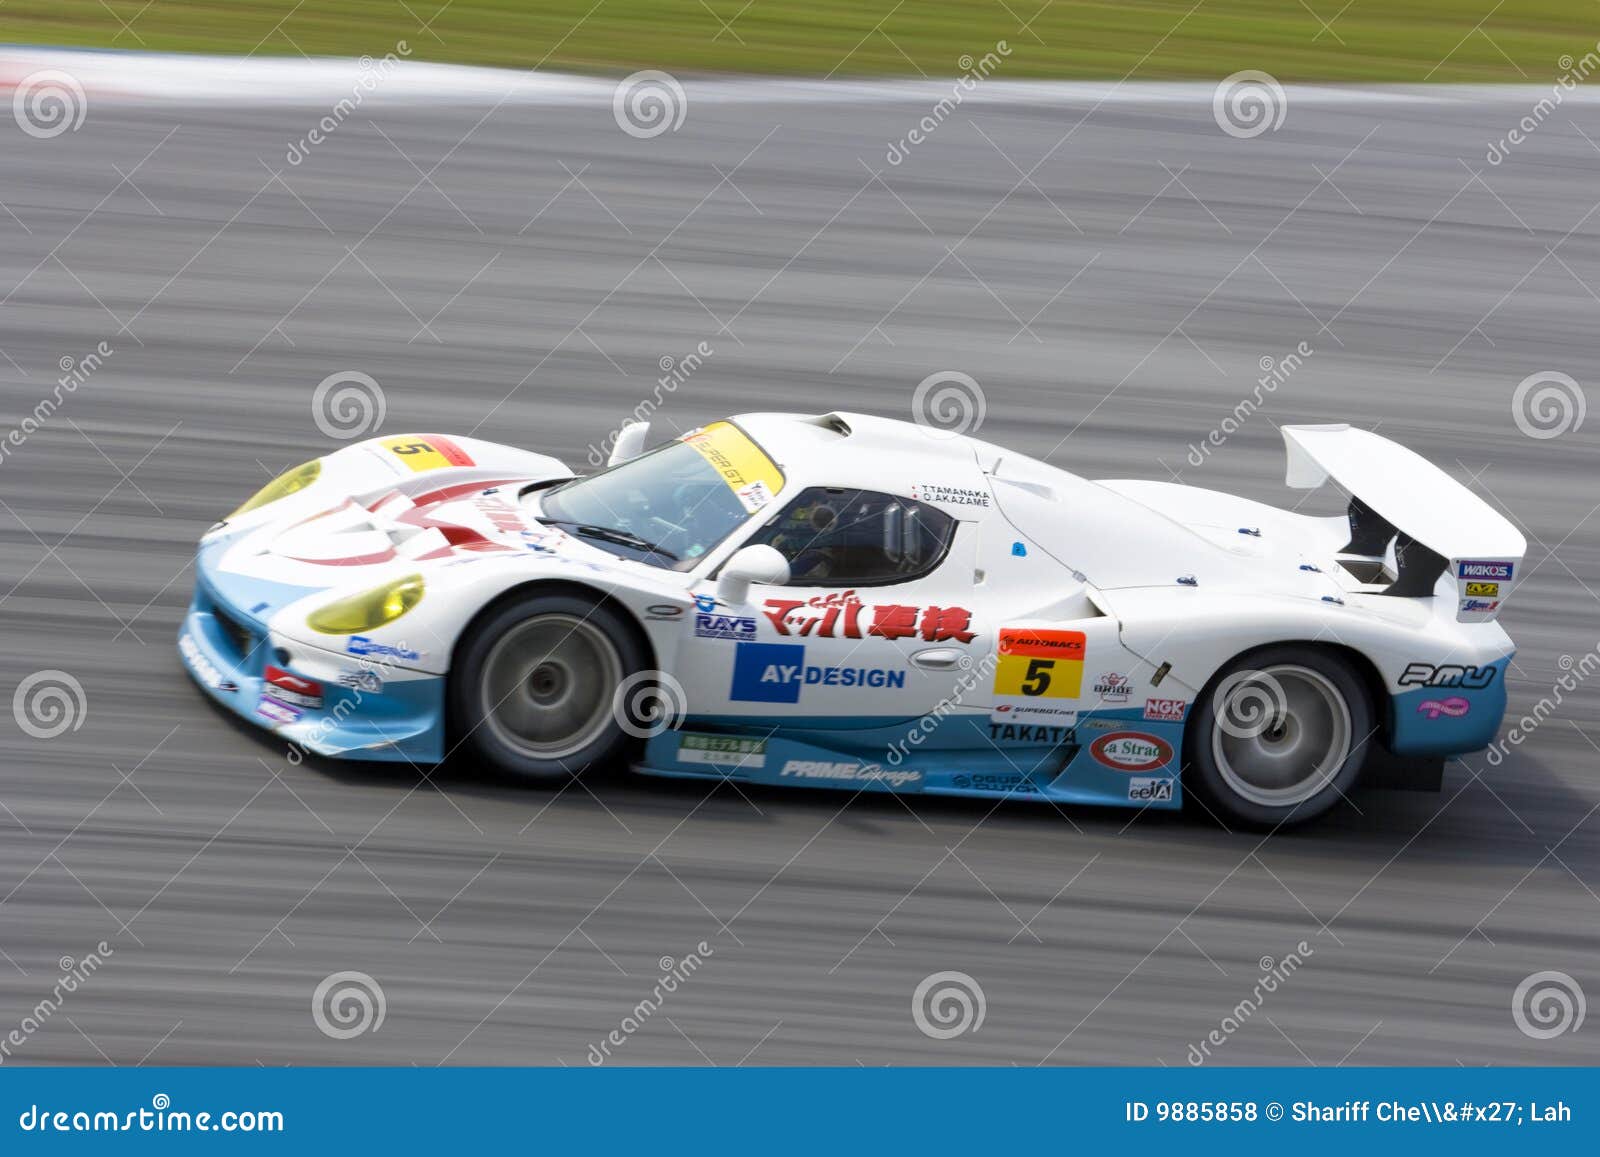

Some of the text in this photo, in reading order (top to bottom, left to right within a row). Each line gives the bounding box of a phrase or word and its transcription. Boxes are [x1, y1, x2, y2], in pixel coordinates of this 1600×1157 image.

[1463, 565, 1508, 576] WAKOS
[695, 615, 758, 634] RAYS
[1016, 638, 1082, 650] AUTOBACS
[759, 664, 906, 689] AY-DESIGN
[1021, 658, 1056, 697] 5
[1093, 684, 1135, 695] BRIDE
[1147, 699, 1185, 715] NGK
[987, 723, 1078, 745] TAKATA
[780, 760, 859, 779] PRIME
